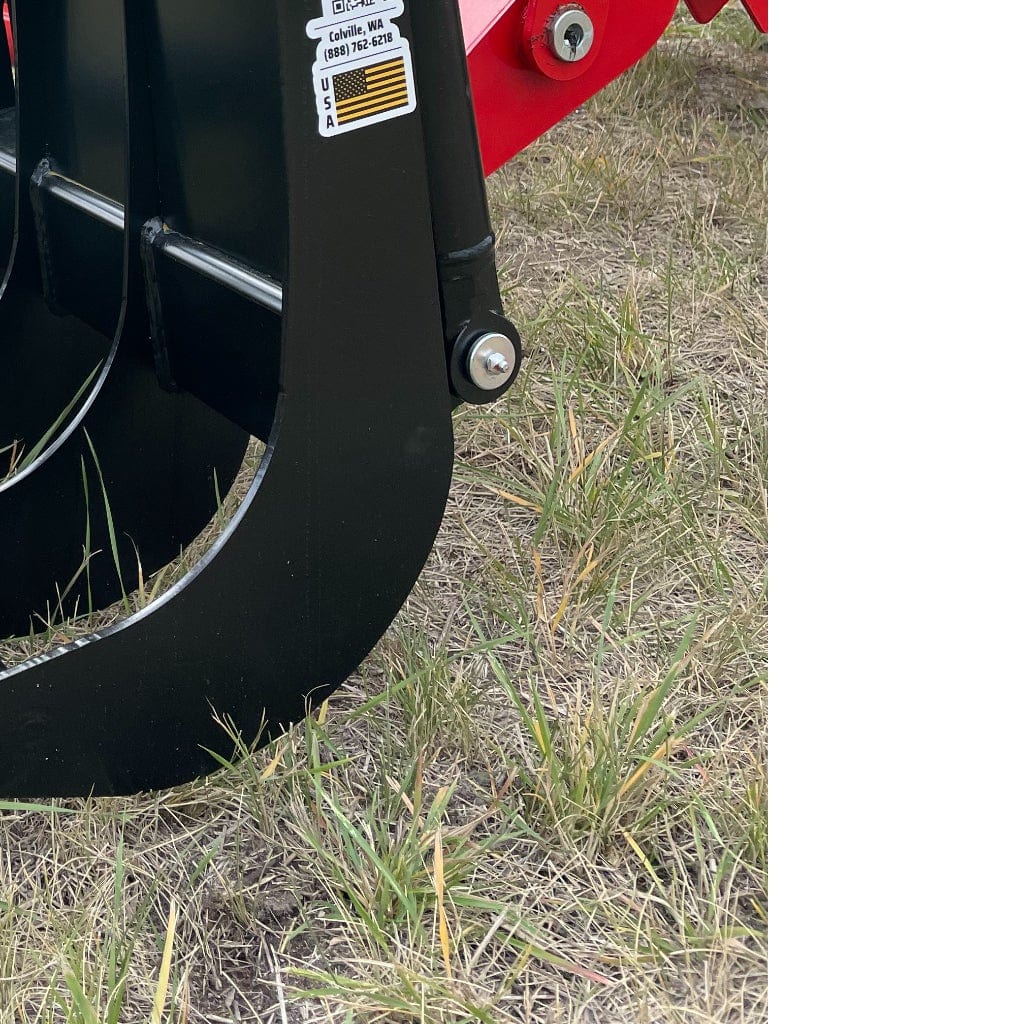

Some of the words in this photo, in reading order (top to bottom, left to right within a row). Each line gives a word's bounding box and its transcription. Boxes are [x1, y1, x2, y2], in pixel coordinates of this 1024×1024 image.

[329, 24, 366, 43] Colville,
[367, 18, 384, 31] WA
[323, 42, 350, 62] (888)
[351, 31, 393, 53] 762-6218
